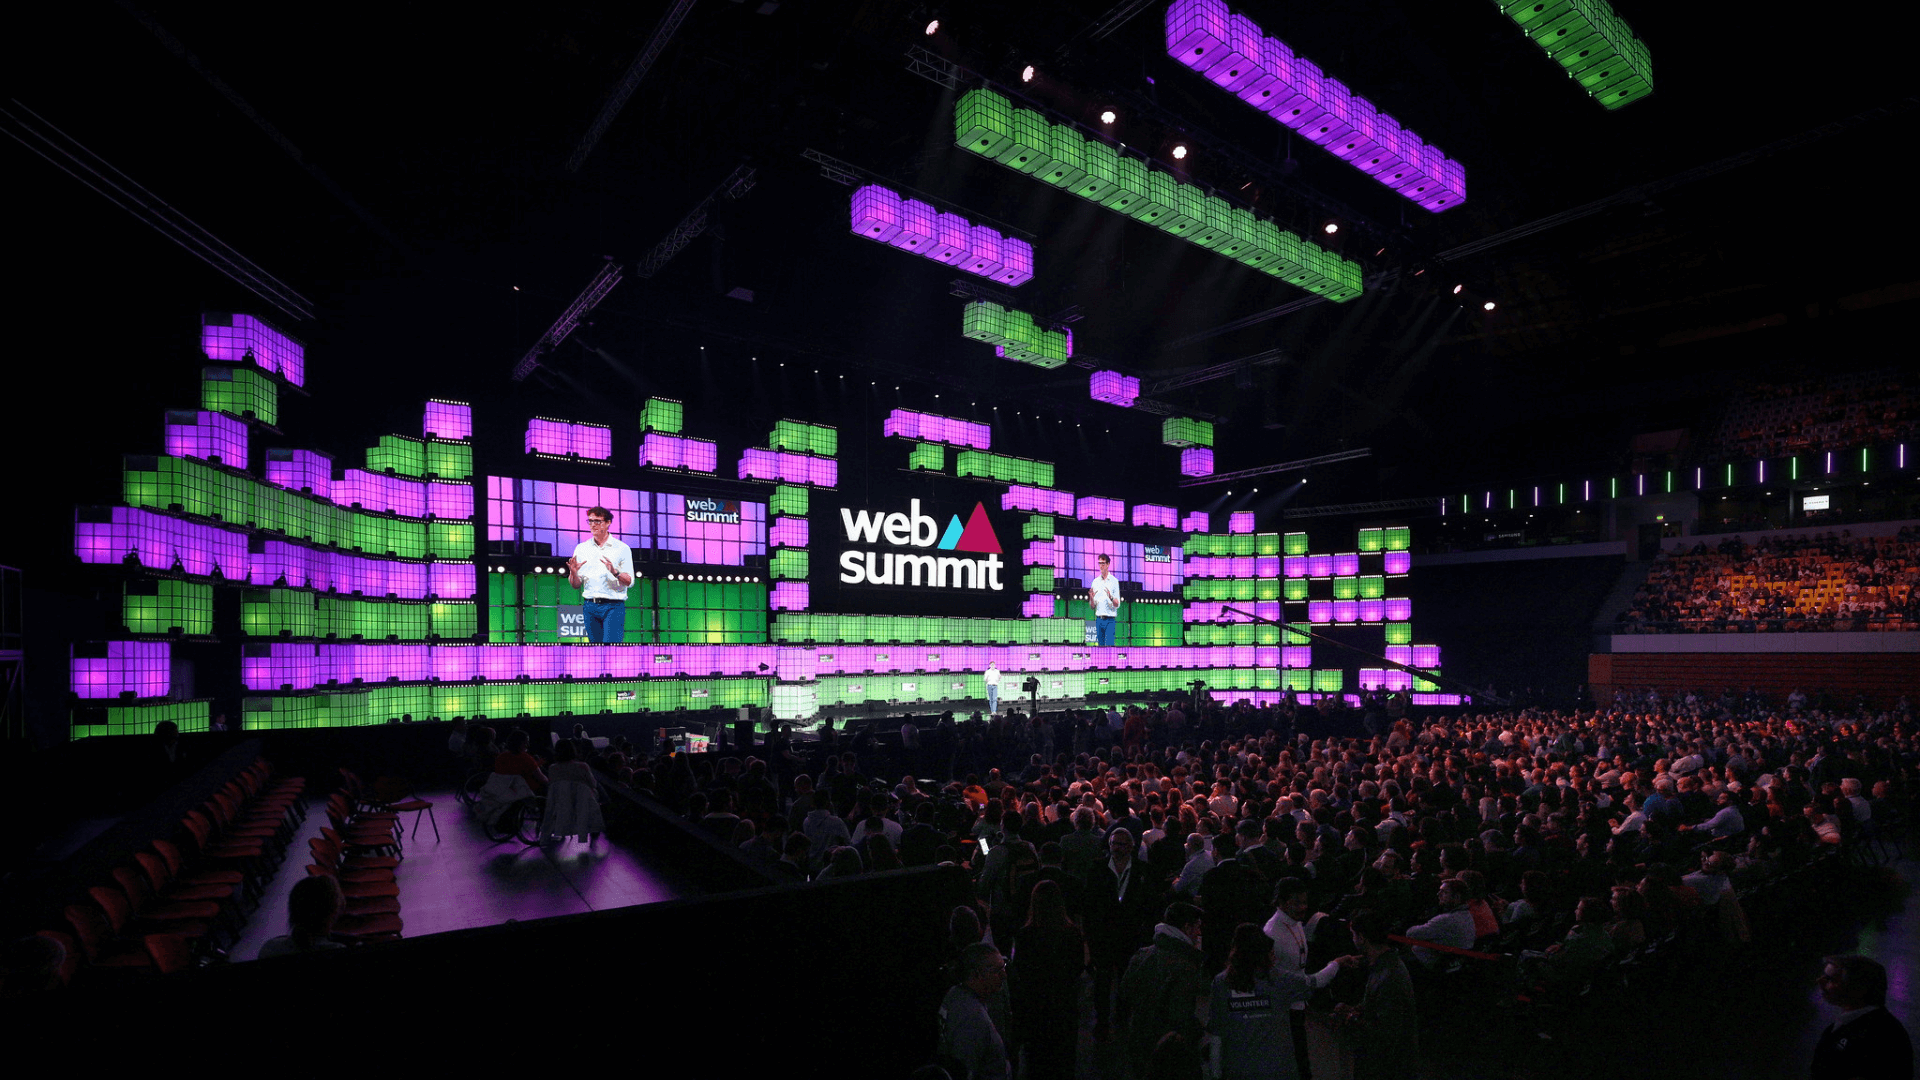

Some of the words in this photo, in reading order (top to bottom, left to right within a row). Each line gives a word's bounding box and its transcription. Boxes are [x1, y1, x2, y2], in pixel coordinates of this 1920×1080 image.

[687, 498, 717, 511] web
[687, 510, 739, 524] summit
[840, 498, 938, 547] web
[1145, 544, 1160, 555] web
[839, 550, 1004, 590] summit
[560, 613, 585, 624] we
[1230, 1000, 1269, 1008] VOLUNTEER
